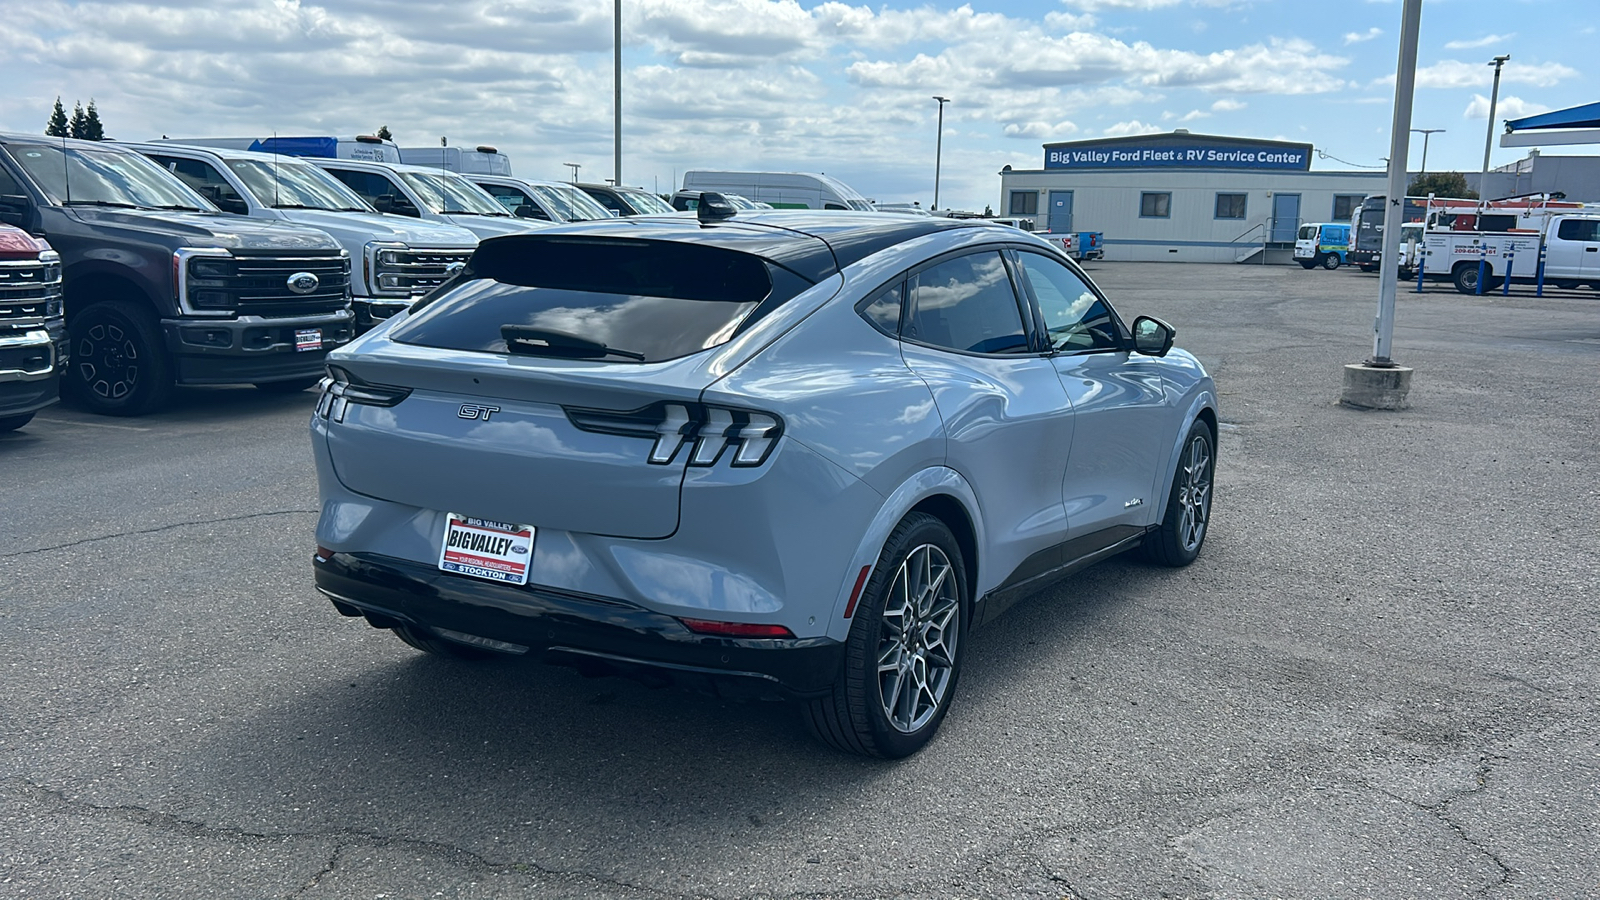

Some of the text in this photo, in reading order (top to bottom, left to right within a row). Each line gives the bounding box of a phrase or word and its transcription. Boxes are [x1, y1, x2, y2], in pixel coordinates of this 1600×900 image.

[1050, 150, 1302, 164] Big Valley Ford Fleet & RV Service Center
[458, 403, 501, 421] GT
[468, 518, 513, 531] BIG VALLEY
[448, 530, 513, 556] BIGVALLEY
[458, 565, 506, 579] STOCKTON
